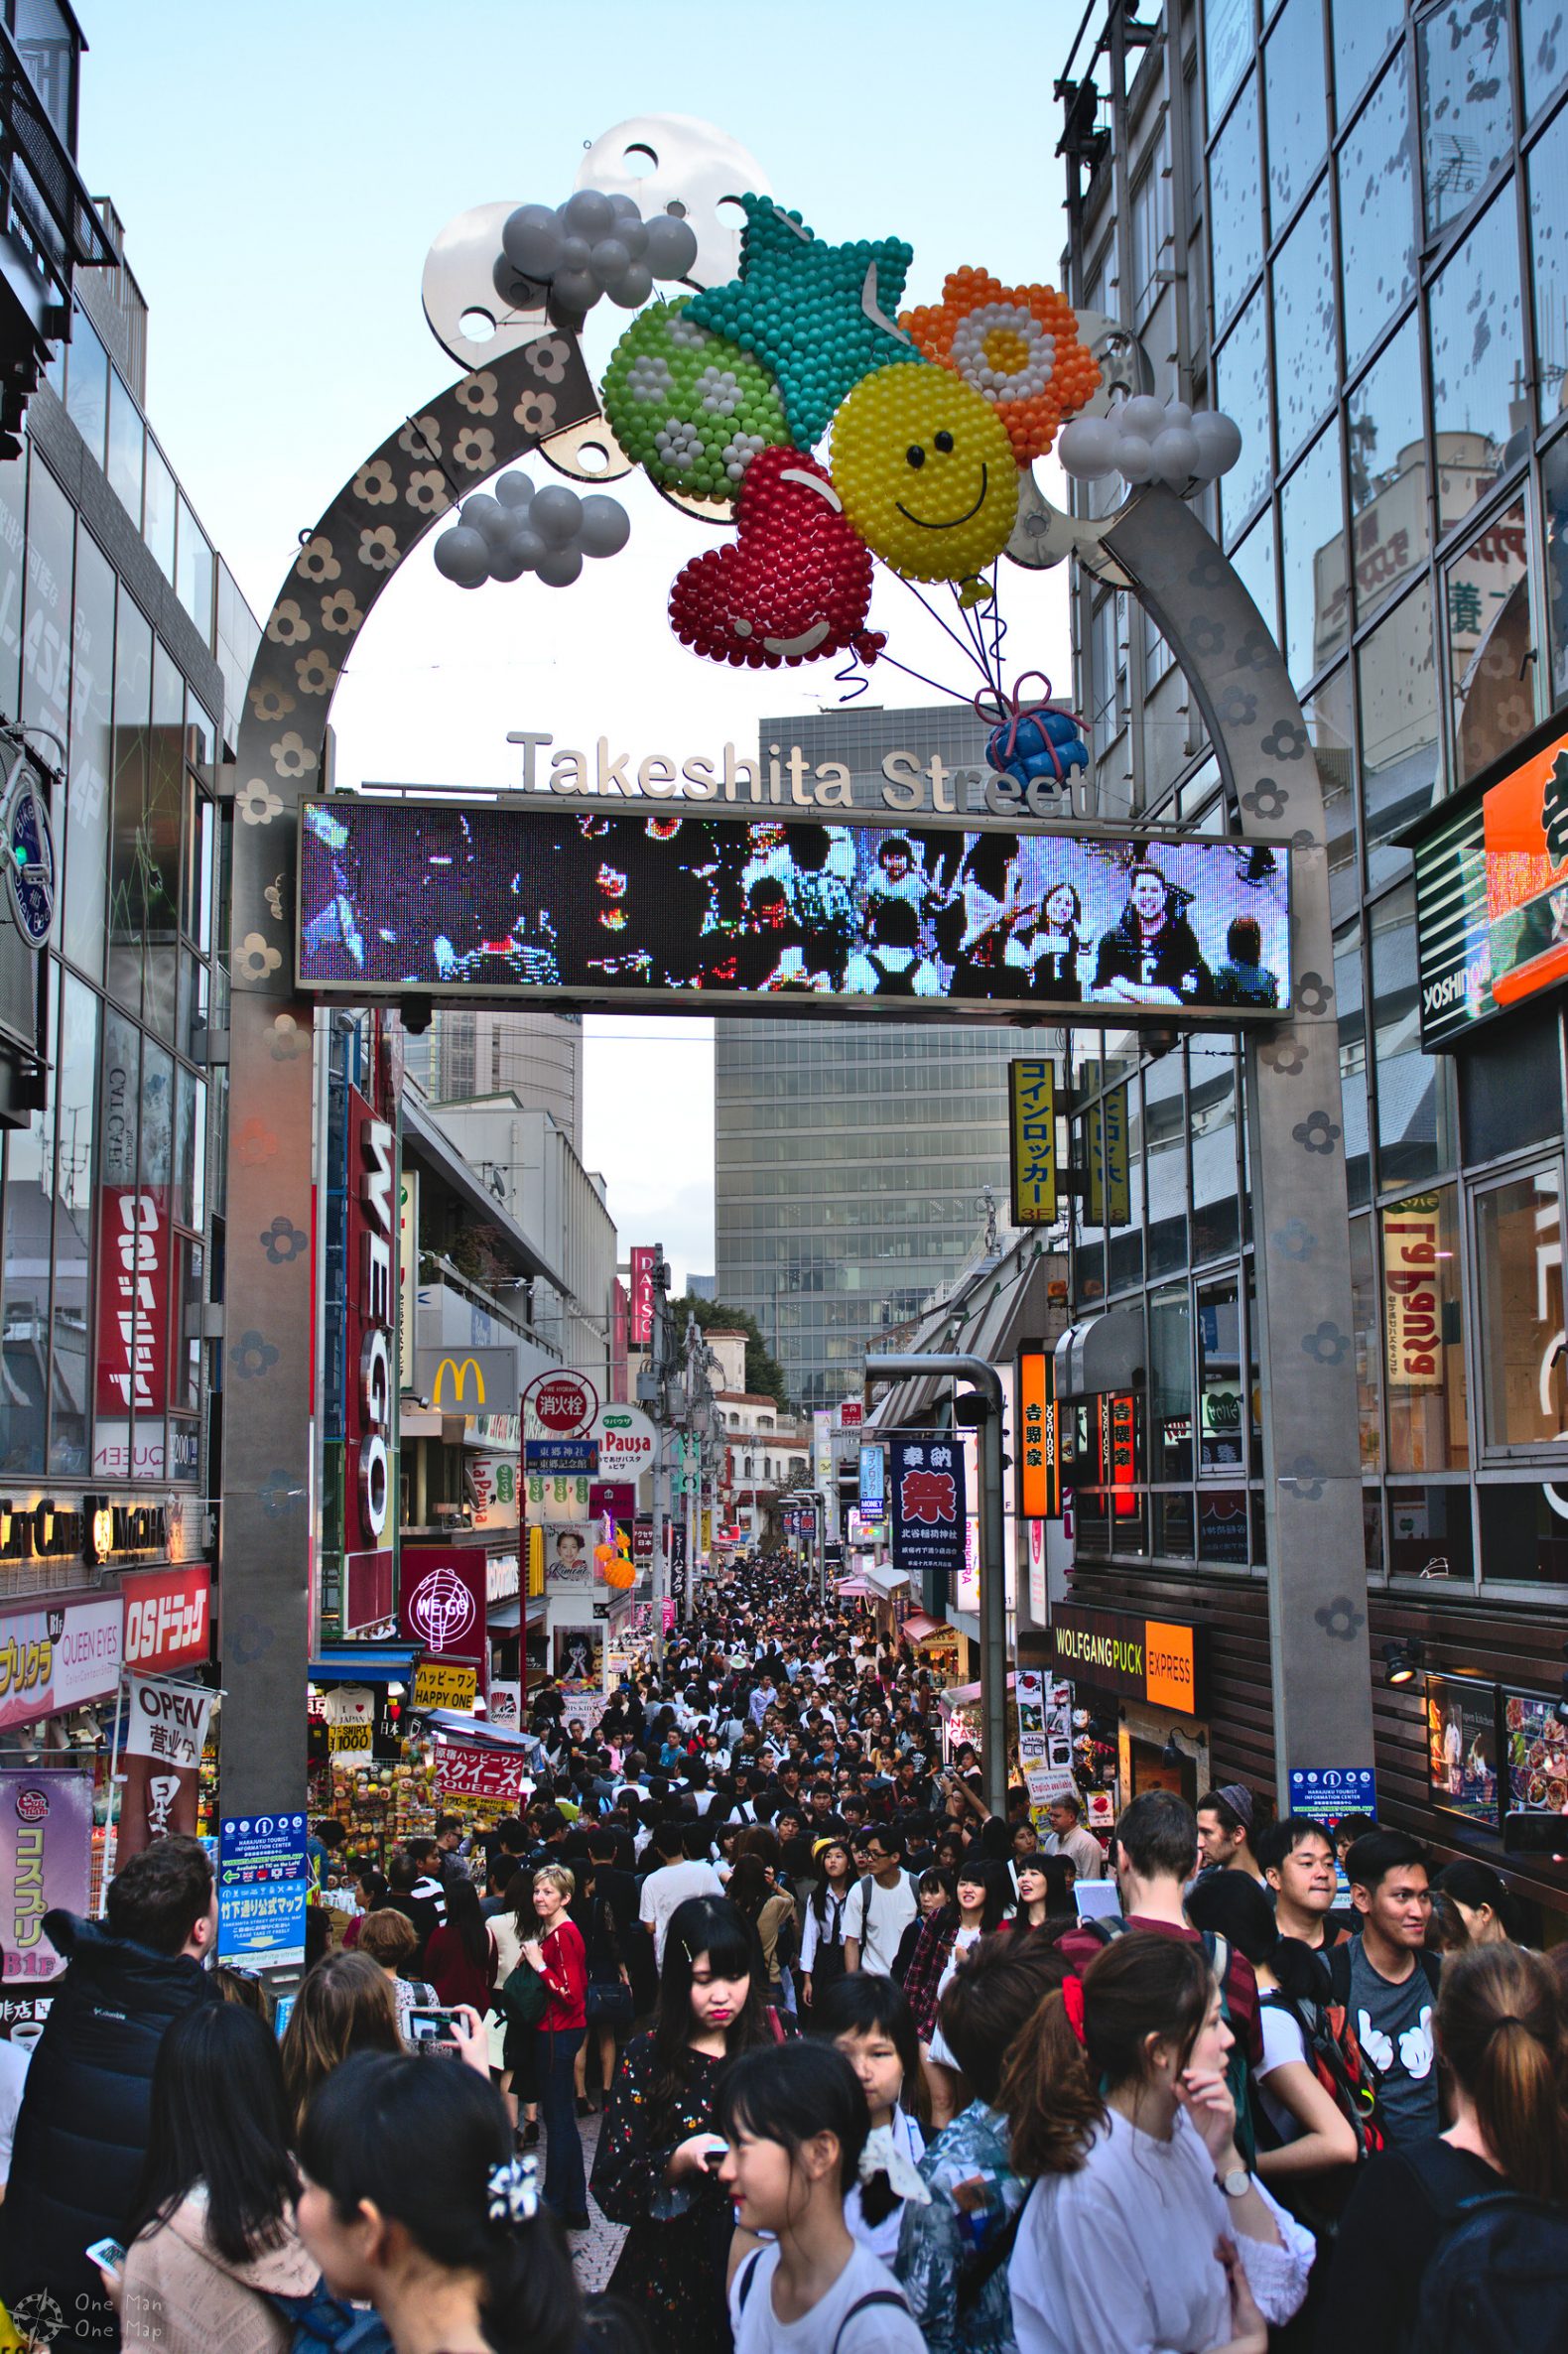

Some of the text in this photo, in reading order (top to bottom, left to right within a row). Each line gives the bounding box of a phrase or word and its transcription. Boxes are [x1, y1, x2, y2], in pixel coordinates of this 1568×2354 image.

[506, 730, 1090, 820] Takeshita Street
[1020, 1063, 1052, 1204] コインロッカー
[1021, 1208, 1052, 1221] 3F
[540, 1396, 584, 1416] 消火栓
[606, 1431, 651, 1454] Pausa
[1025, 1402, 1042, 1467] 吉野家
[540, 1446, 584, 1457] 東郷神社
[902, 1446, 952, 1467] 奉納
[860, 1500, 883, 1508] MONEY
[900, 1470, 958, 1524] 祭
[50, 1612, 64, 1636] B1F
[125, 1588, 207, 1662] OSドラッグ
[63, 1626, 118, 1667] QUEEN EYES
[1056, 1628, 1190, 1684] WOLFGANG PUCK EXPRESS
[419, 1671, 475, 1688] ハッピーワン
[139, 1687, 204, 1729] OPEN
[416, 1689, 473, 1709] HAPPY ONE
[330, 1725, 368, 1736] T-SHIRT
[381, 1721, 399, 1736] 日本
[328, 1734, 369, 1751] ¥1000
[436, 1748, 522, 1766] 原宿ハッピーワン
[436, 1760, 521, 1787] スクイーズ
[434, 1778, 517, 1797] SQUEEZE
[14, 1828, 48, 1948] コスプリ
[221, 1893, 305, 1920] 竹下通り公式マップ
[3, 1952, 57, 1976] B1F
